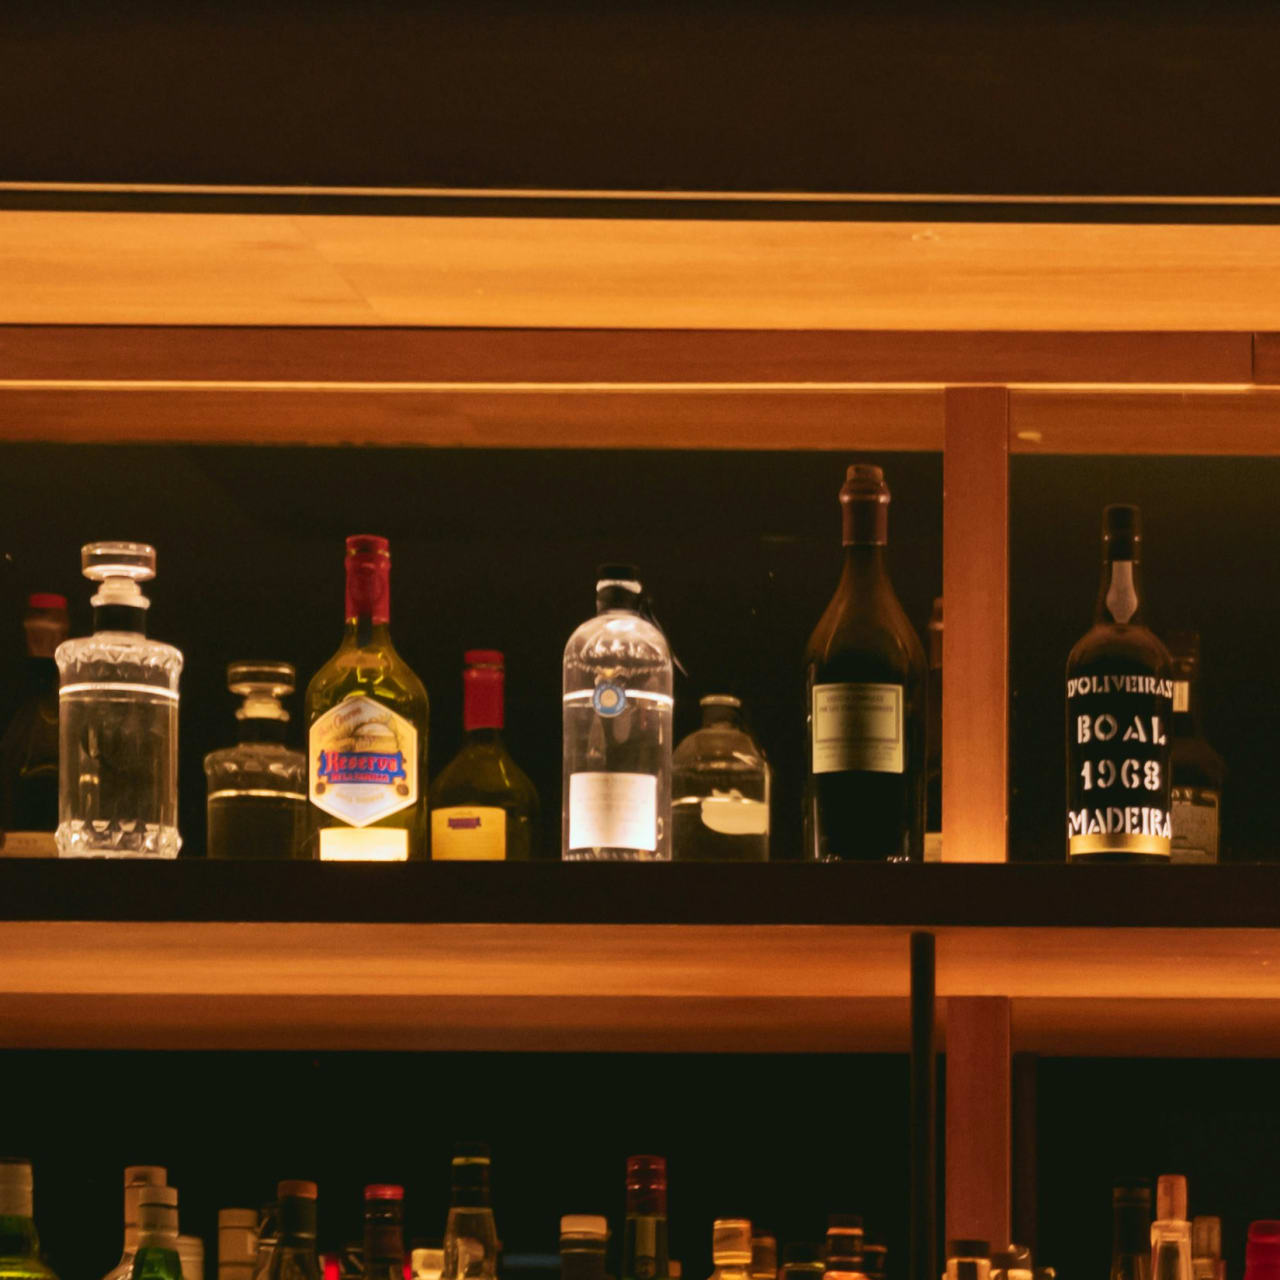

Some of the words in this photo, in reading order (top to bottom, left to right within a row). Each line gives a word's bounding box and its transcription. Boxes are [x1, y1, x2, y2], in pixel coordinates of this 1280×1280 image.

[1067, 676, 1173, 698] D'OLIVEIRAS
[1077, 712, 1167, 746] BOAL
[1081, 758, 1161, 791] 1968
[1068, 806, 1173, 839] MADEIRA
